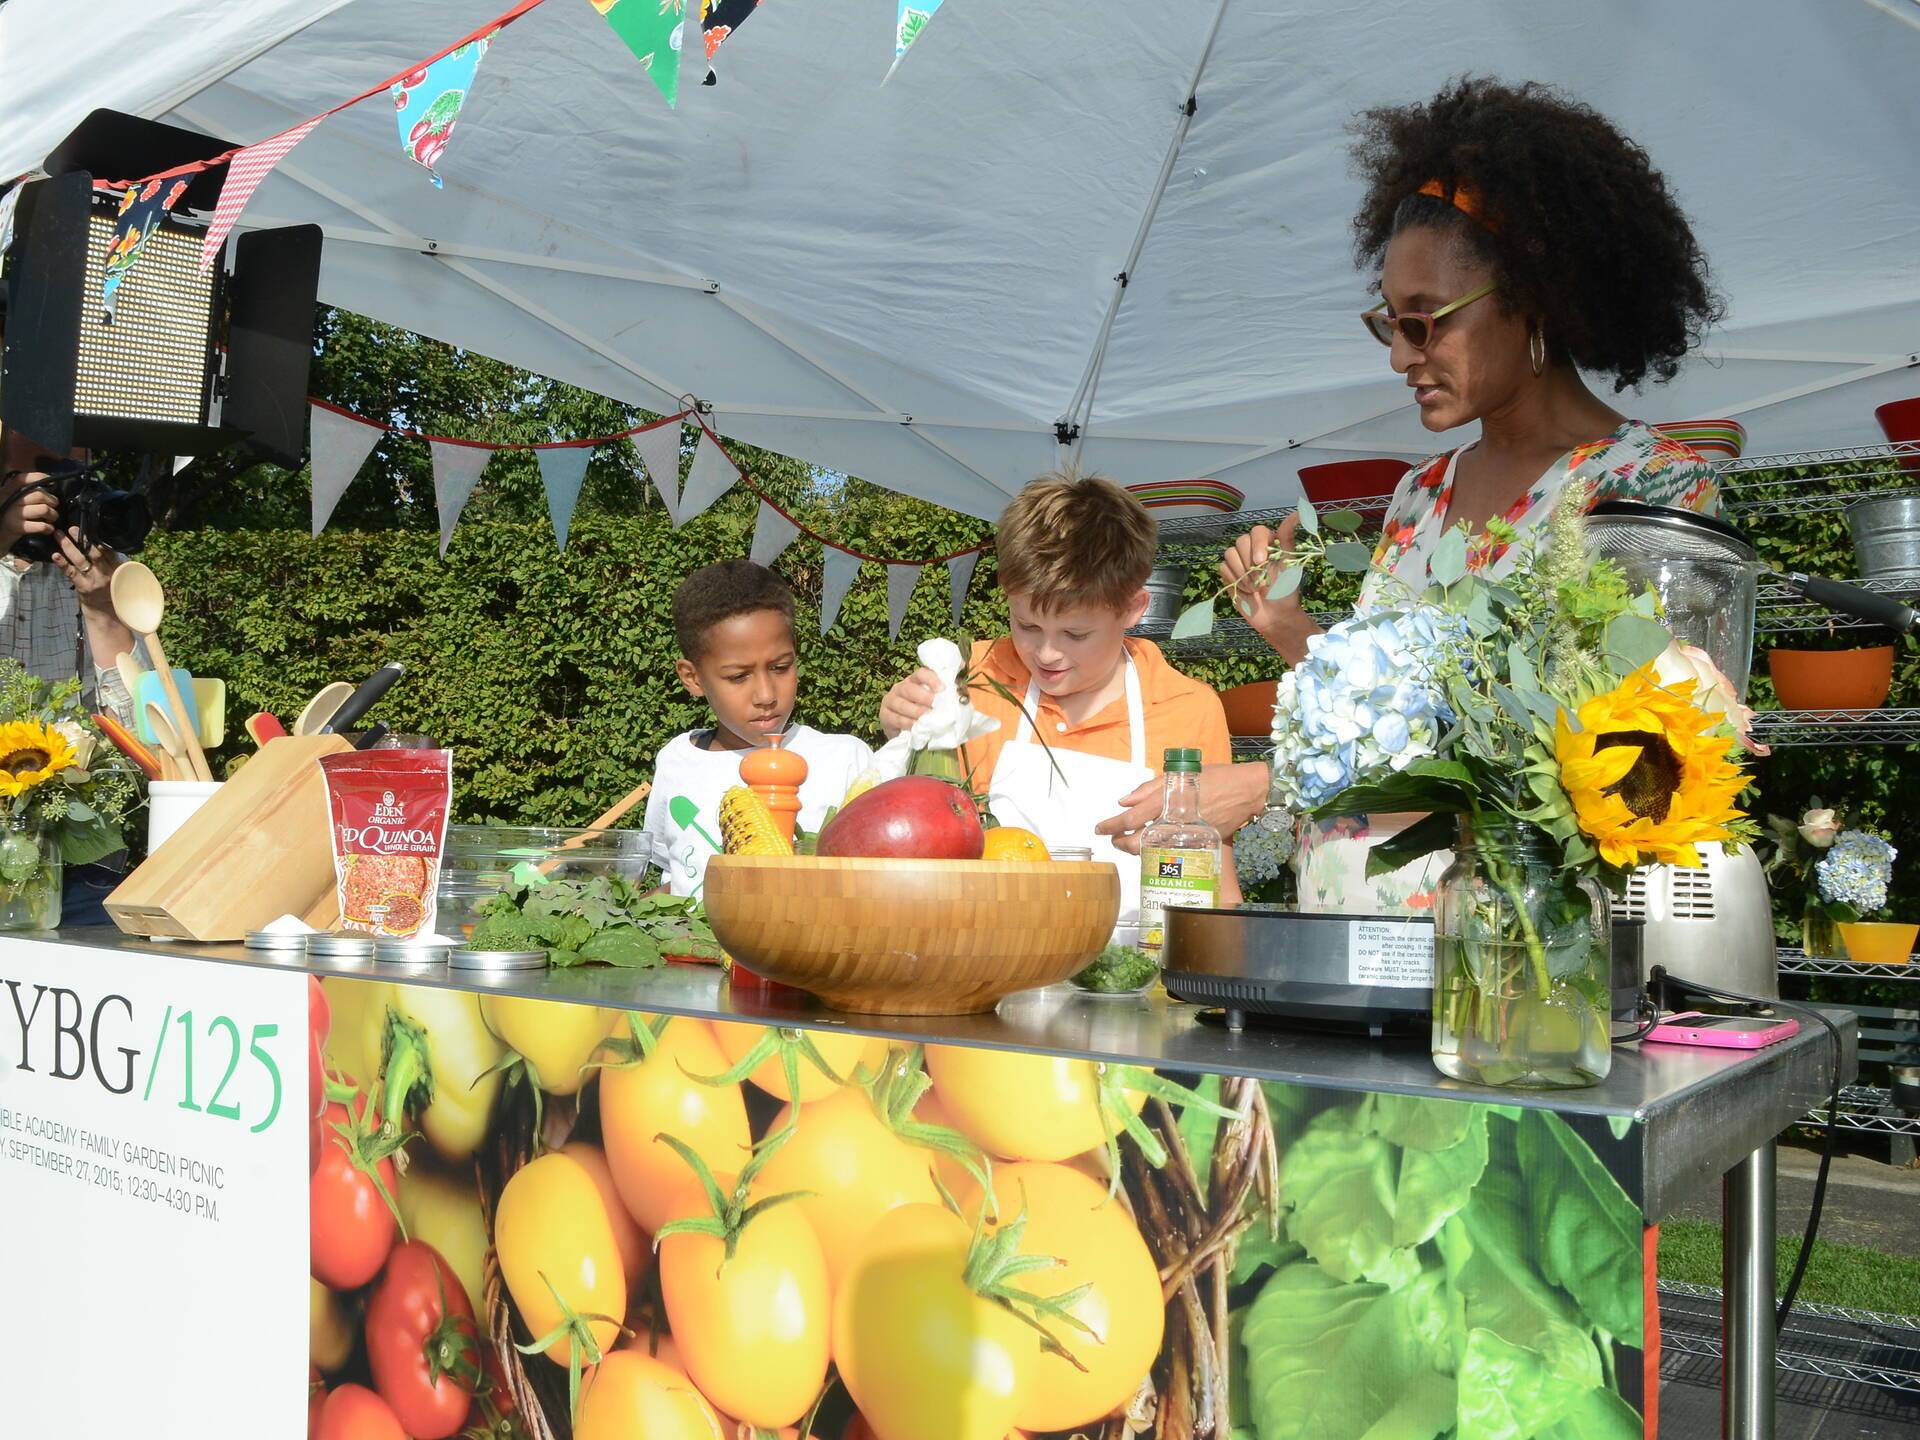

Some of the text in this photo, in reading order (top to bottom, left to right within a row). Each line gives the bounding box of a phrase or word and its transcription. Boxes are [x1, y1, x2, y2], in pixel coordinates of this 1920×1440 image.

[375, 803, 404, 816] EDEN
[368, 816, 407, 825] ORGANIC
[359, 826, 437, 854] QUINOA
[1161, 864, 1179, 875] 365
[1149, 878, 1195, 888] ORGANIC
[0, 979, 282, 1133] YBG/125
[25, 1115, 77, 1146] ACADEMY
[80, 1130, 120, 1159] FAMILY
[123, 1142, 175, 1175] GARDEN
[180, 1157, 224, 1189] PICNIC
[9, 1139, 73, 1176] SEPTEMBER
[76, 1160, 91, 1185] 27,
[94, 1165, 123, 1196] 2015;
[196, 1195, 220, 1222] P.M.
